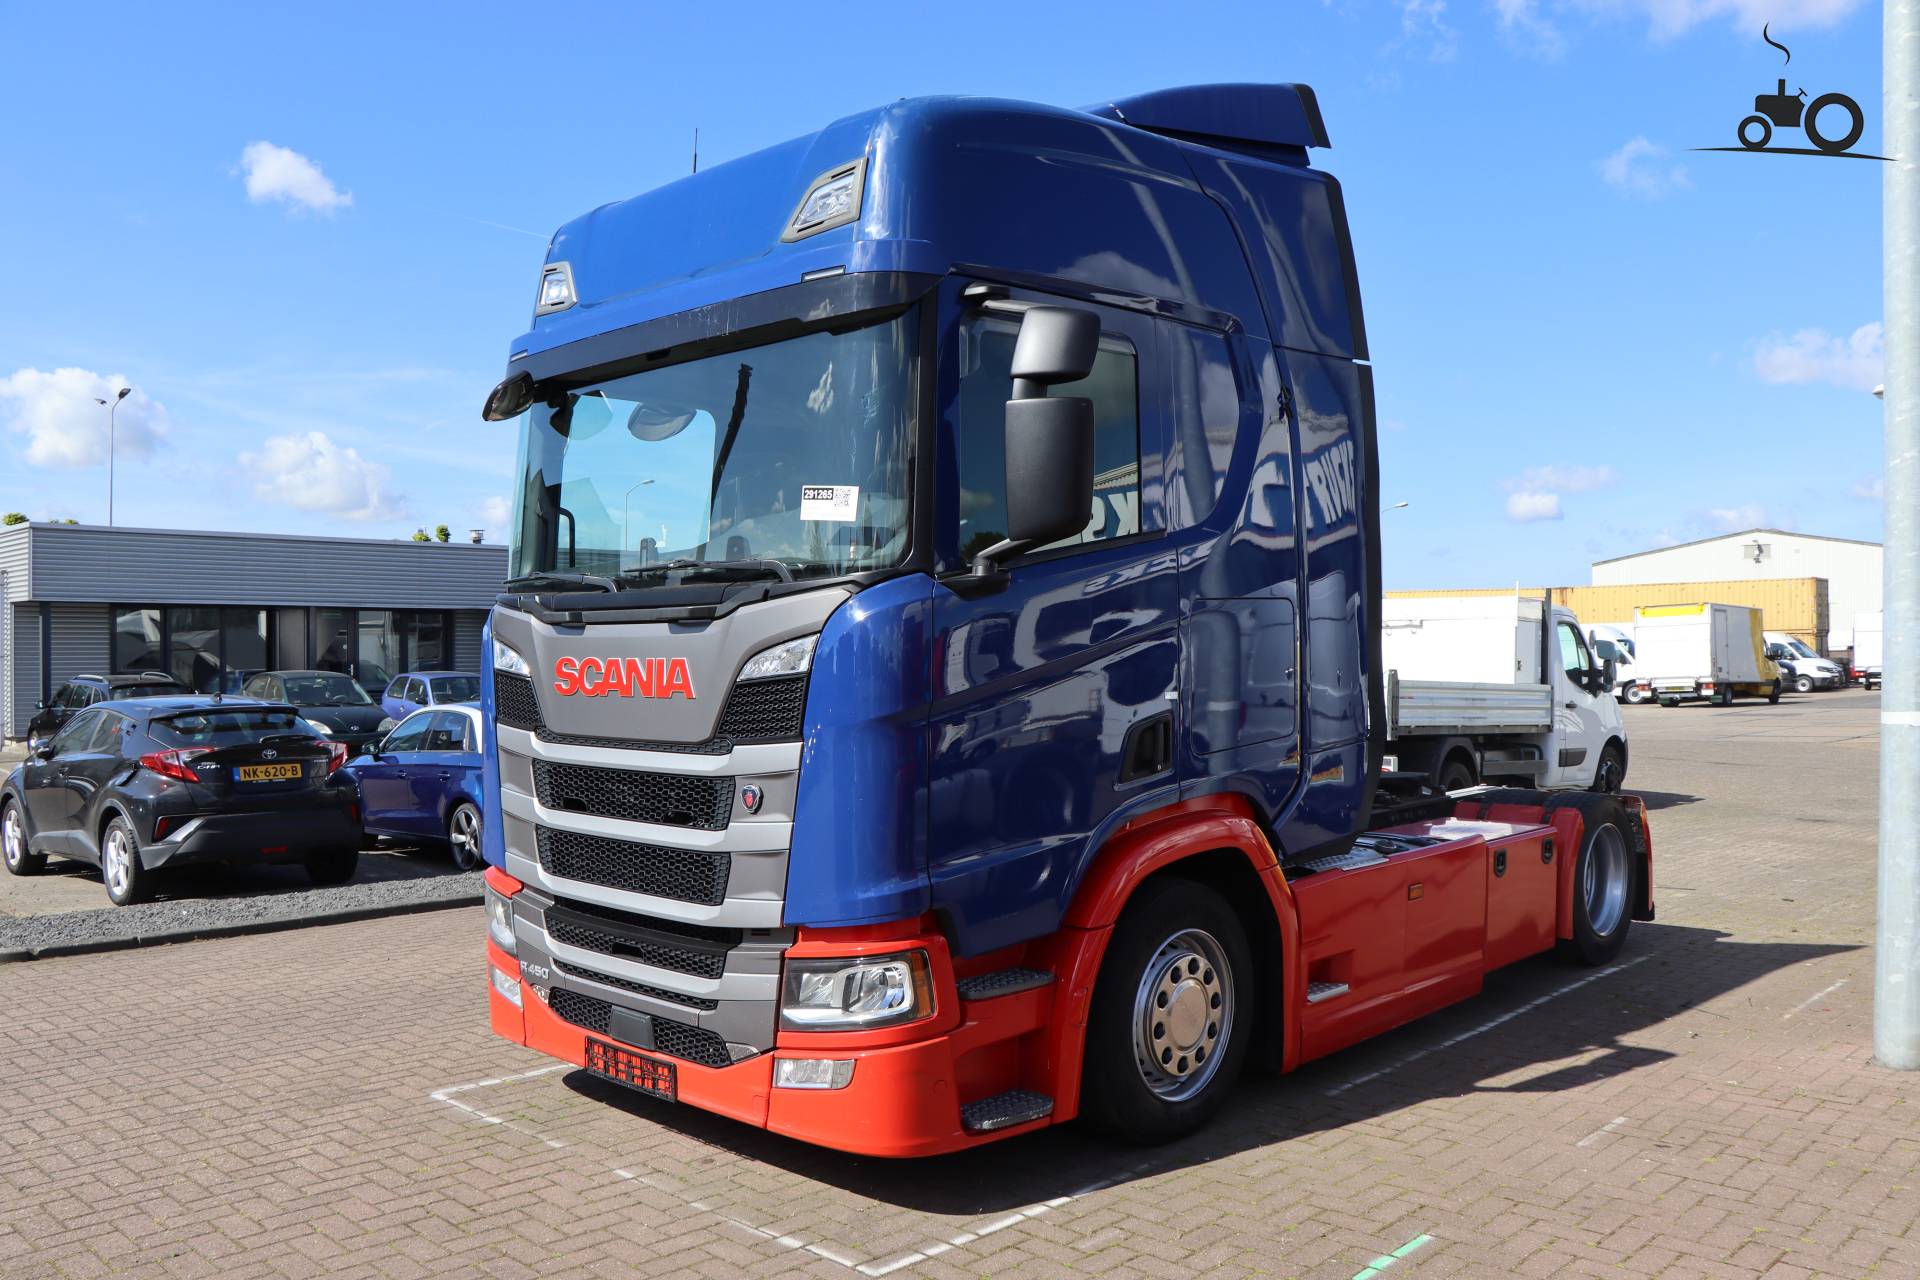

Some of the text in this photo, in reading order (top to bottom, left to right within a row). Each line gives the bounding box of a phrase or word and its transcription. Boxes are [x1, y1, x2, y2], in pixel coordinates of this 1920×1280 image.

[804, 489, 833, 499] 291265
[553, 656, 696, 699] SCANIA
[243, 766, 298, 779] NK-620-B
